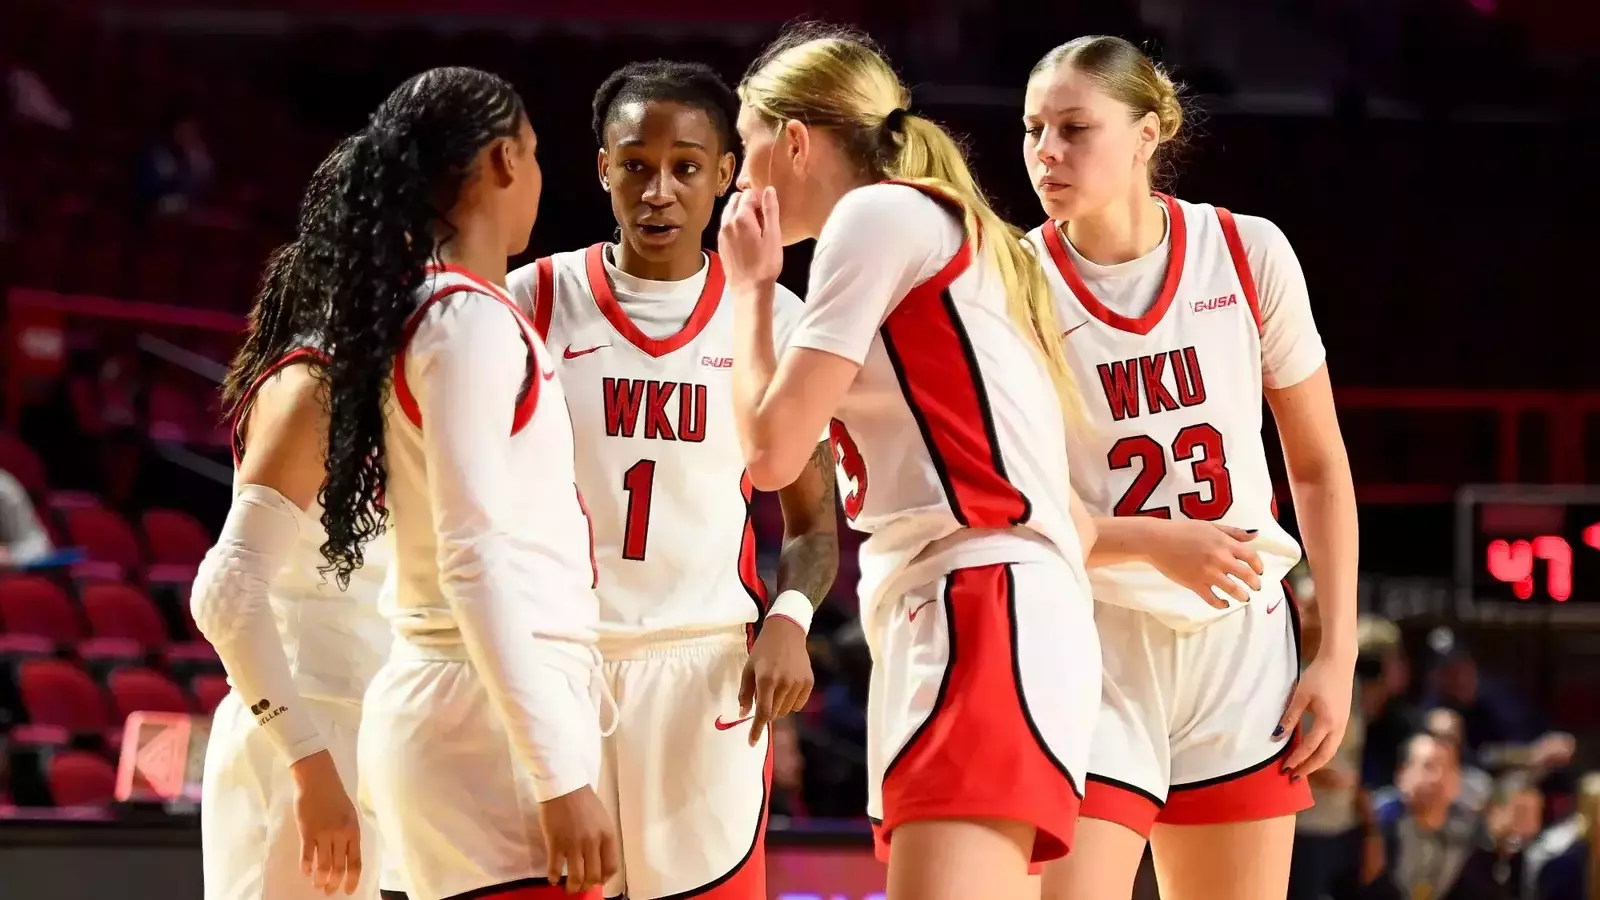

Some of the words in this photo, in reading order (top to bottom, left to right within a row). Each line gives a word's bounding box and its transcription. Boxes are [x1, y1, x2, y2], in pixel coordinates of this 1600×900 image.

[603, 377, 708, 443] WKU
[1096, 346, 1206, 421] WKU
[1107, 423, 1233, 521] 23
[622, 459, 656, 561] 1
[1487, 535, 1573, 602] 47
